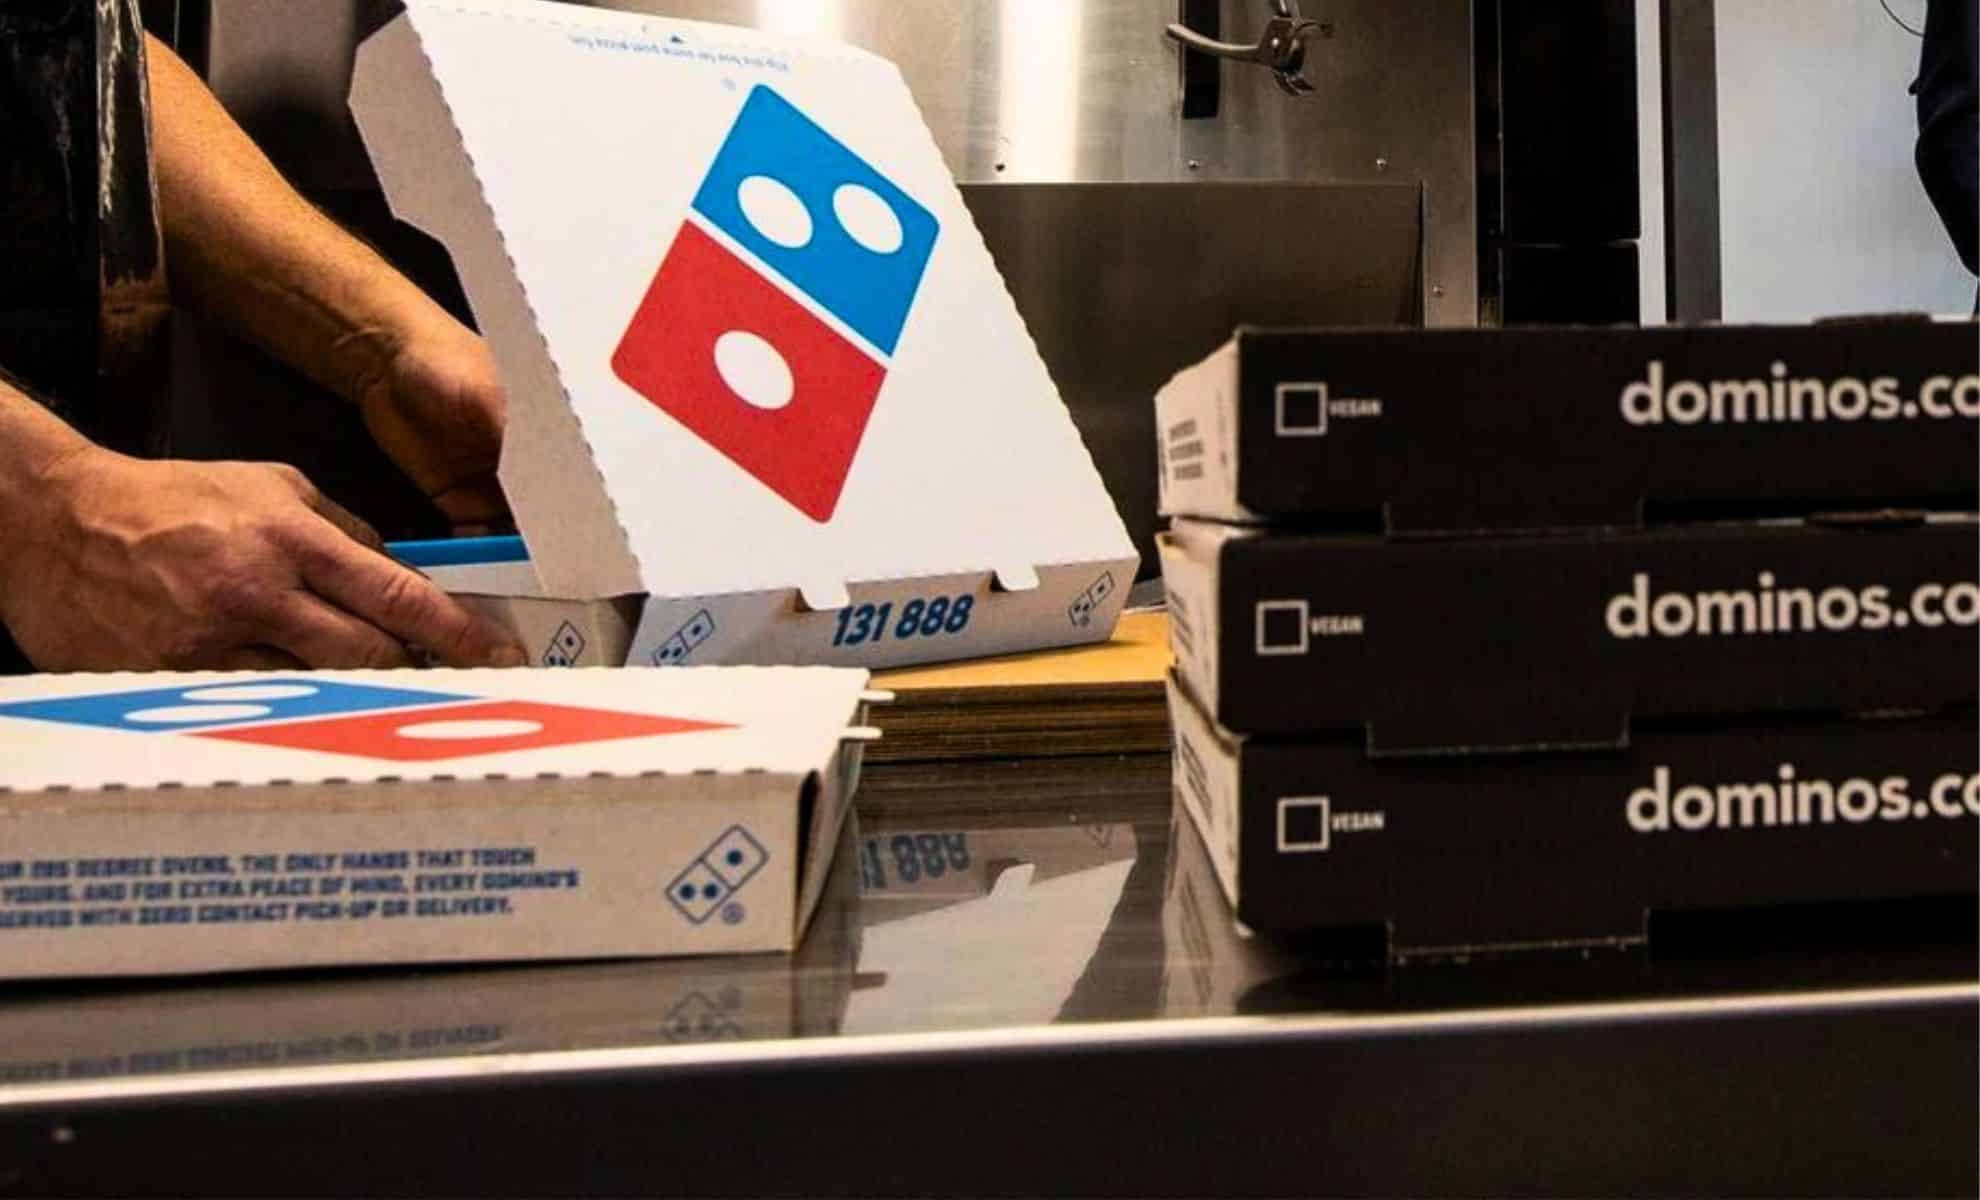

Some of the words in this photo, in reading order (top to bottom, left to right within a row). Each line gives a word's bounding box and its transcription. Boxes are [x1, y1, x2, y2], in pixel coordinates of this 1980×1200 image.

[1327, 399, 1383, 417] VEGAN
[1606, 572, 1979, 638] dominos.co
[832, 602, 893, 647] 131
[895, 593, 975, 639] 888
[1310, 615, 1364, 635] VEGAN
[1331, 811, 1385, 831] VEGAN
[240, 854, 277, 873] THE
[417, 850, 464, 867] THAT
[471, 848, 535, 866] TOUCH
[132, 881, 173, 900] FOR
[179, 879, 244, 899] EXTRA
[249, 877, 312, 897] PEACE
[319, 876, 344, 895] OF
[414, 873, 476, 892] EVERY
[197, 902, 288, 923] CONTACT
[382, 899, 409, 917] OR
